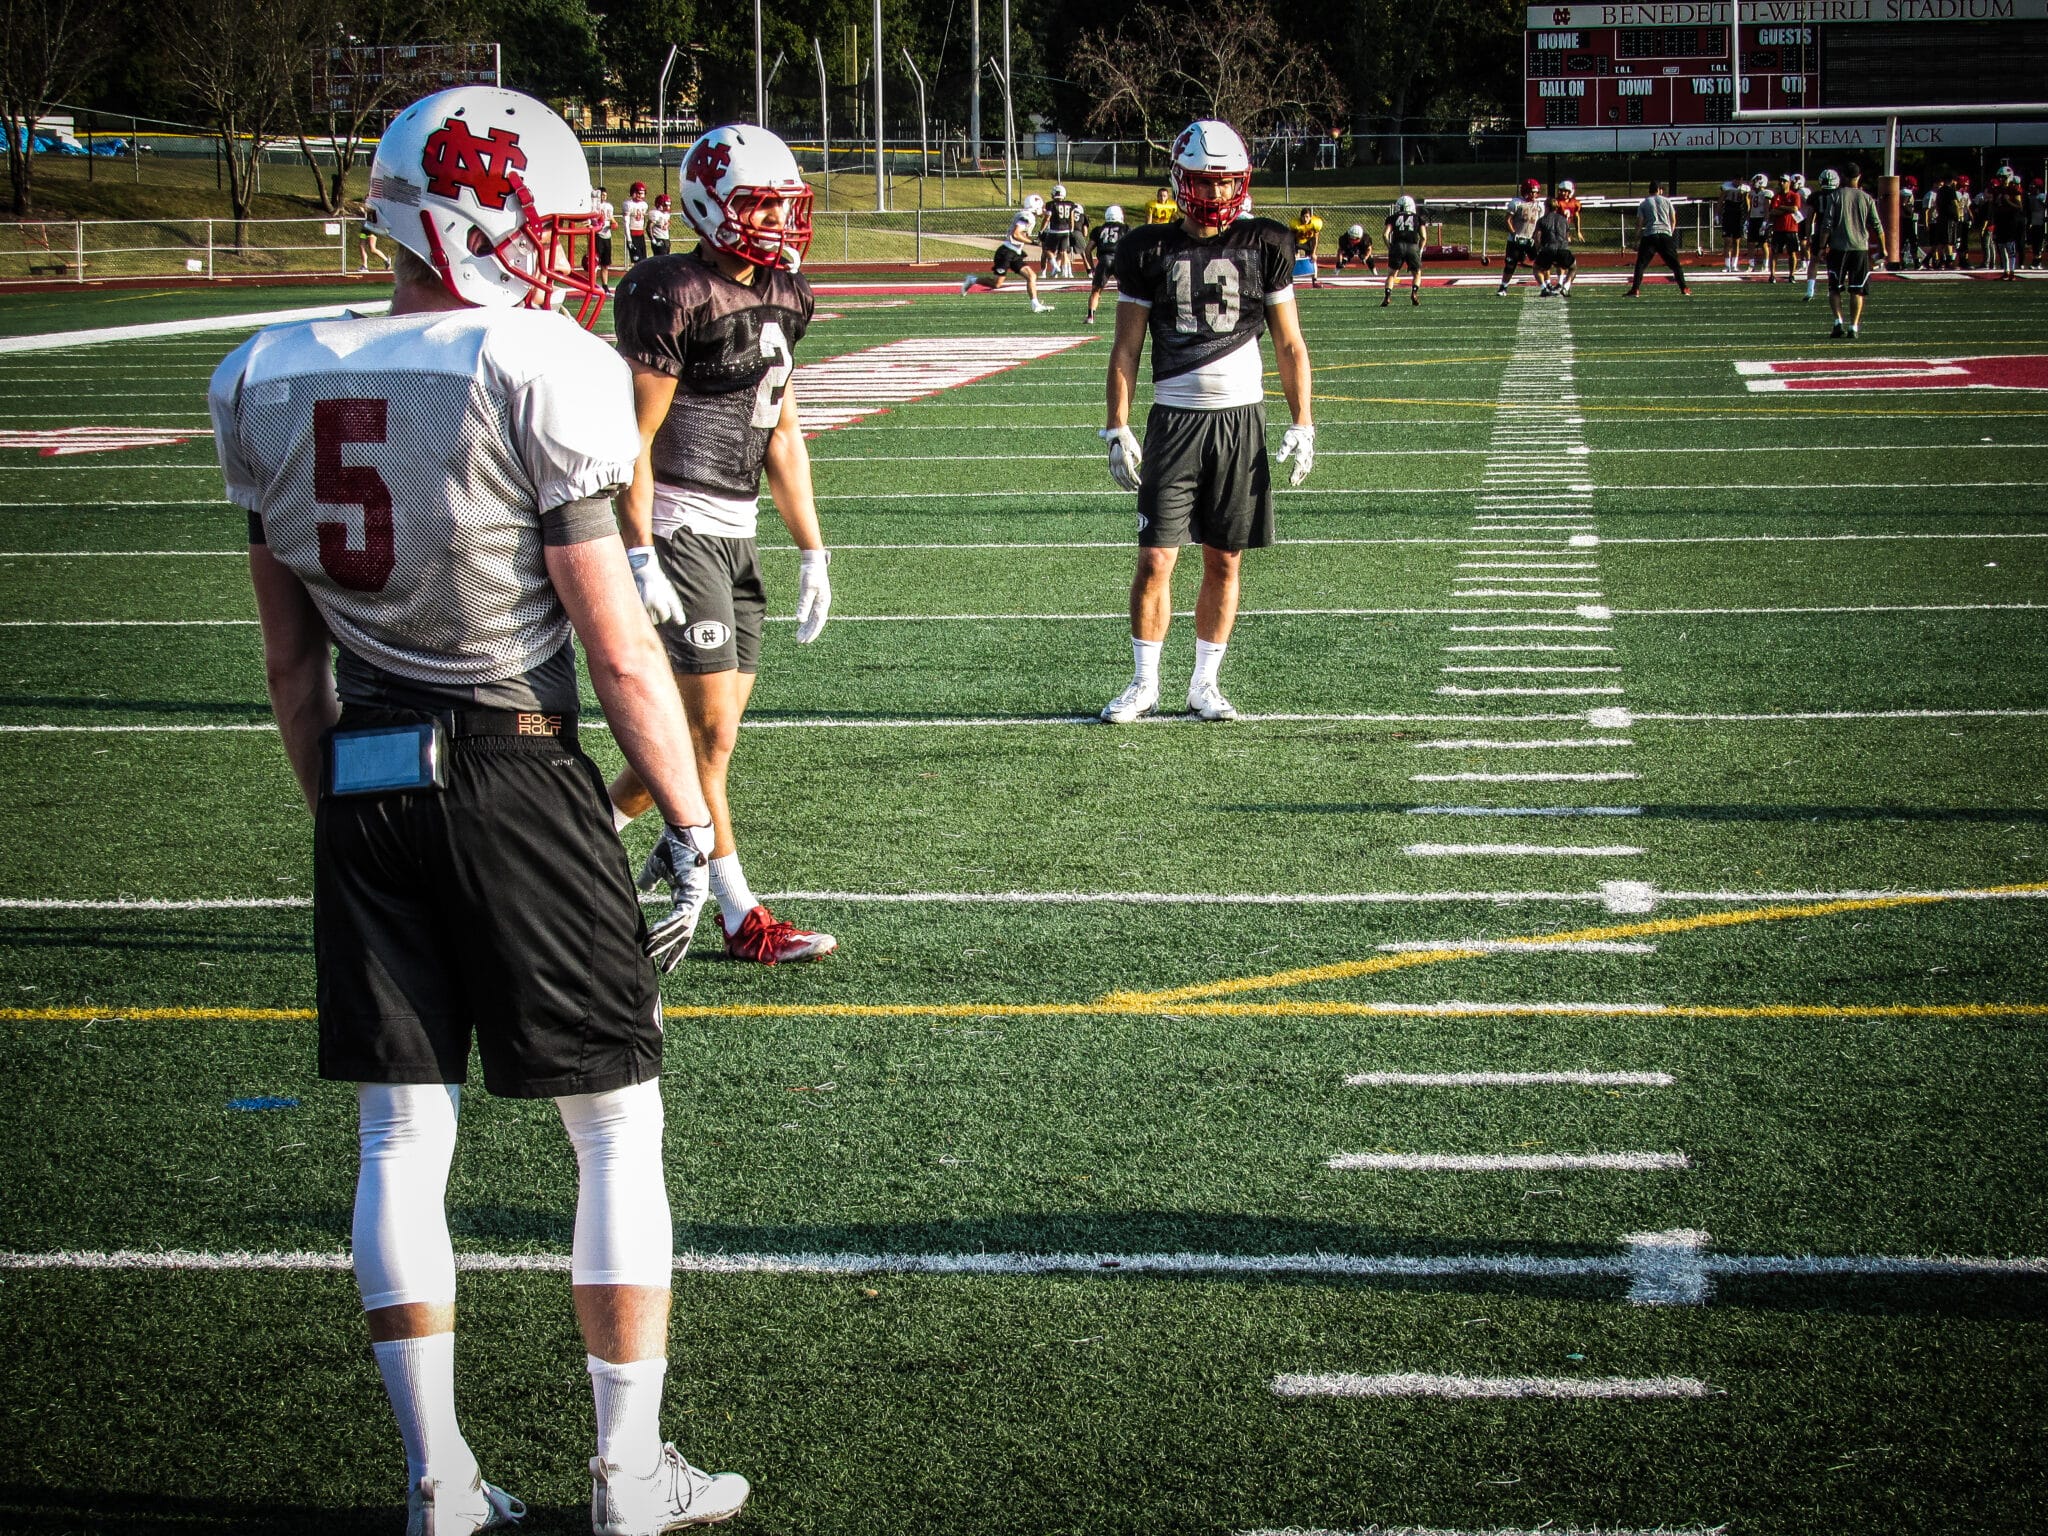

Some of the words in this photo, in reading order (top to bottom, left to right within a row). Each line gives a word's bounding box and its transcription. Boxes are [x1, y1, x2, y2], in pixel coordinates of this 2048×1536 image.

[1887, 0, 2014, 18] STADIUM
[1538, 33, 1579, 49] HOME
[1759, 28, 1812, 45] GUESTS
[1540, 81, 1566, 97] BALL
[1569, 80, 1584, 96] ON
[1618, 79, 1652, 96] DOWN
[1692, 78, 1714, 94] YDS
[1716, 78, 1731, 94] TO
[1782, 76, 1806, 93] QTR
[1652, 131, 1682, 149] JAY
[1686, 130, 1714, 146] and
[1720, 130, 1765, 145] DOT
[1771, 129, 1864, 145] BUKEMA
[1872, 128, 1943, 143] TACK
[1395, 215, 1415, 232] 44
[1100, 226, 1120, 244] 45
[1171, 258, 1240, 333] 13
[750, 321, 793, 429] 2
[313, 398, 396, 586] 5
[518, 724, 562, 736] ROUT
